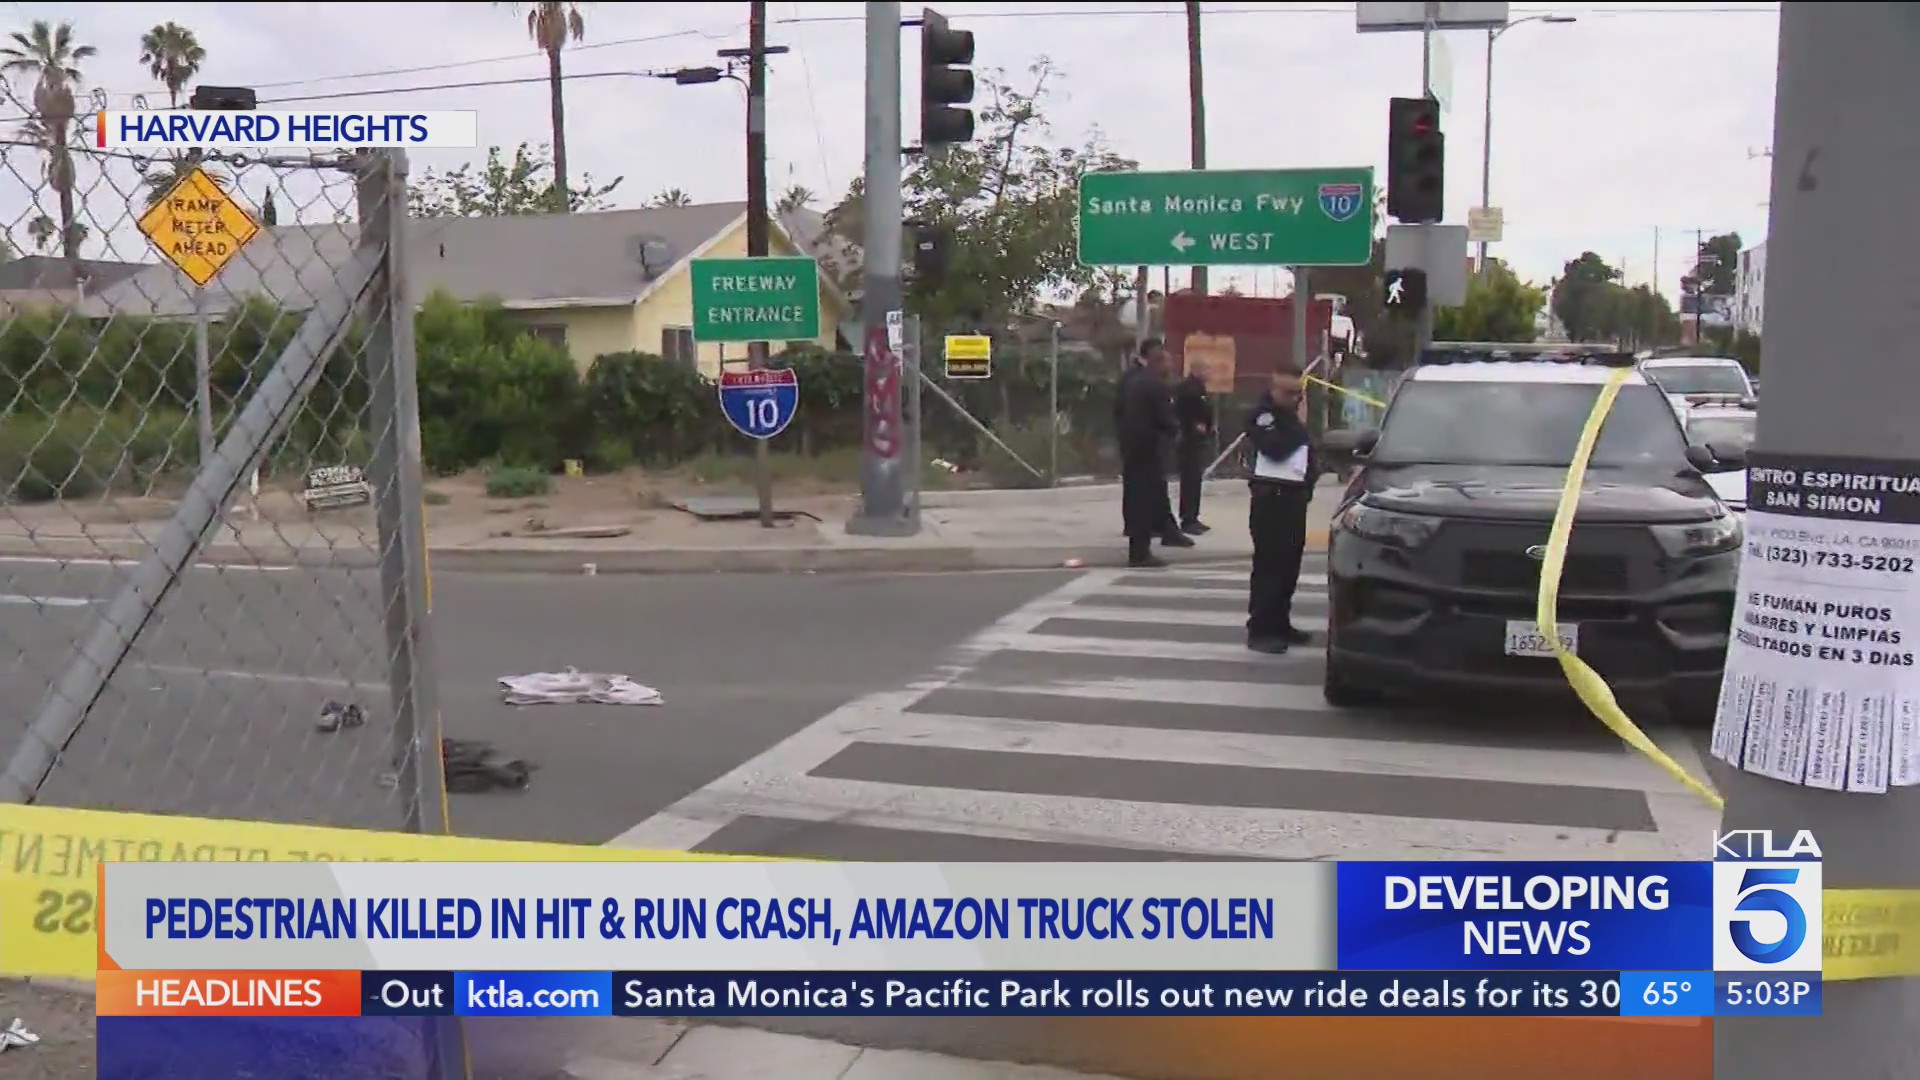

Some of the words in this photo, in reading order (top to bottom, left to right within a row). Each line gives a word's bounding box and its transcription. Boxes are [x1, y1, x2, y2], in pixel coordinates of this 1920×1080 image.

[173, 199, 220, 211] RAMP
[1088, 197, 1151, 214] Santa
[1165, 195, 1242, 214] Monica
[1256, 194, 1303, 215] Fwy
[1330, 196, 1351, 213] 10
[172, 220, 225, 234] METER
[172, 242, 227, 256] AHEAD
[1210, 233, 1275, 250] WEST
[712, 276, 796, 292] FREEWAY
[708, 306, 804, 323] ENTRANCE
[746, 399, 779, 428] 10
[1766, 491, 1800, 508] SAN
[1806, 493, 1881, 514] SIMON
[1767, 546, 1808, 567] (323)
[1816, 551, 1914, 573] 733-5202
[1764, 595, 1817, 614] FUMAN
[1823, 603, 1892, 622] PUROS
[1805, 623, 1816, 636] Y
[1822, 625, 1900, 644] LIMPIAS
[1819, 647, 1845, 661] EN
[1852, 649, 1863, 663] 3
[1870, 651, 1914, 666] DIAS
